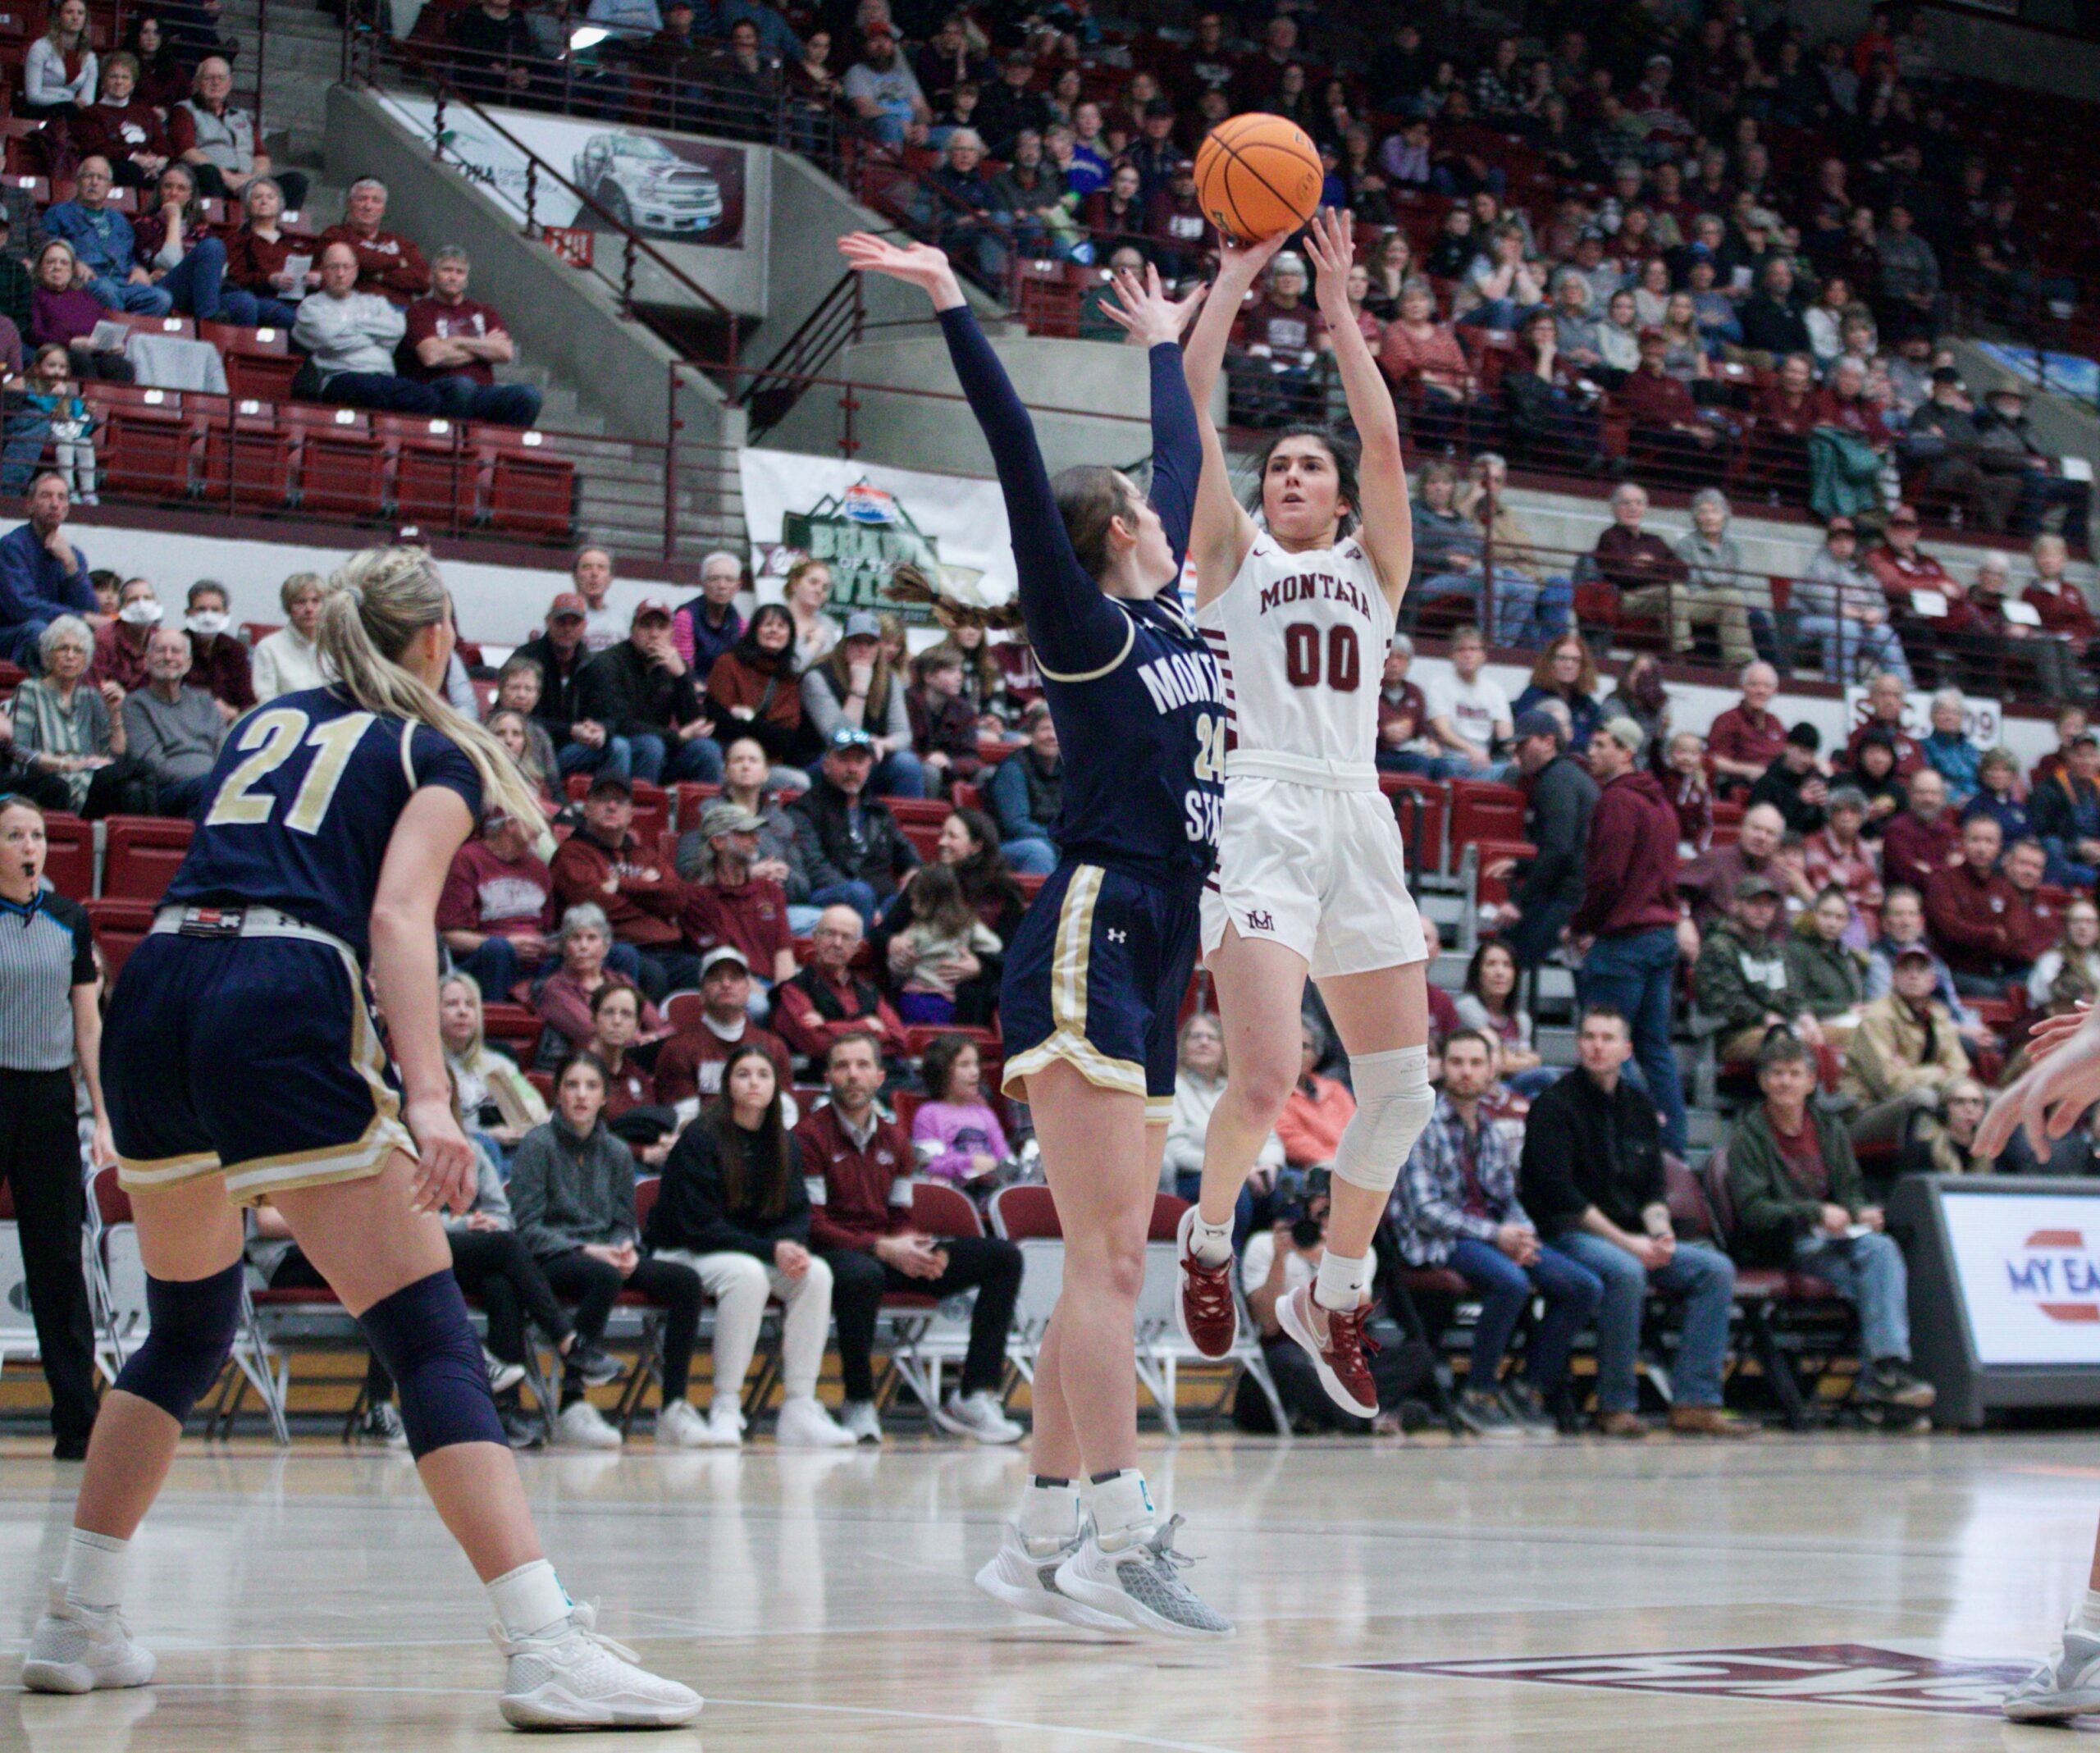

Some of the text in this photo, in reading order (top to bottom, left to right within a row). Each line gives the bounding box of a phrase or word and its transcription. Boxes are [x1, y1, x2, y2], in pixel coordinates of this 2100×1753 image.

[867, 559, 897, 573] TH
[1259, 573, 1371, 622] MONTANA
[1285, 621, 1360, 694] 00
[205, 706, 376, 836] 21
[1194, 712, 1225, 785] 24
[2005, 1258, 2052, 1294] MY
